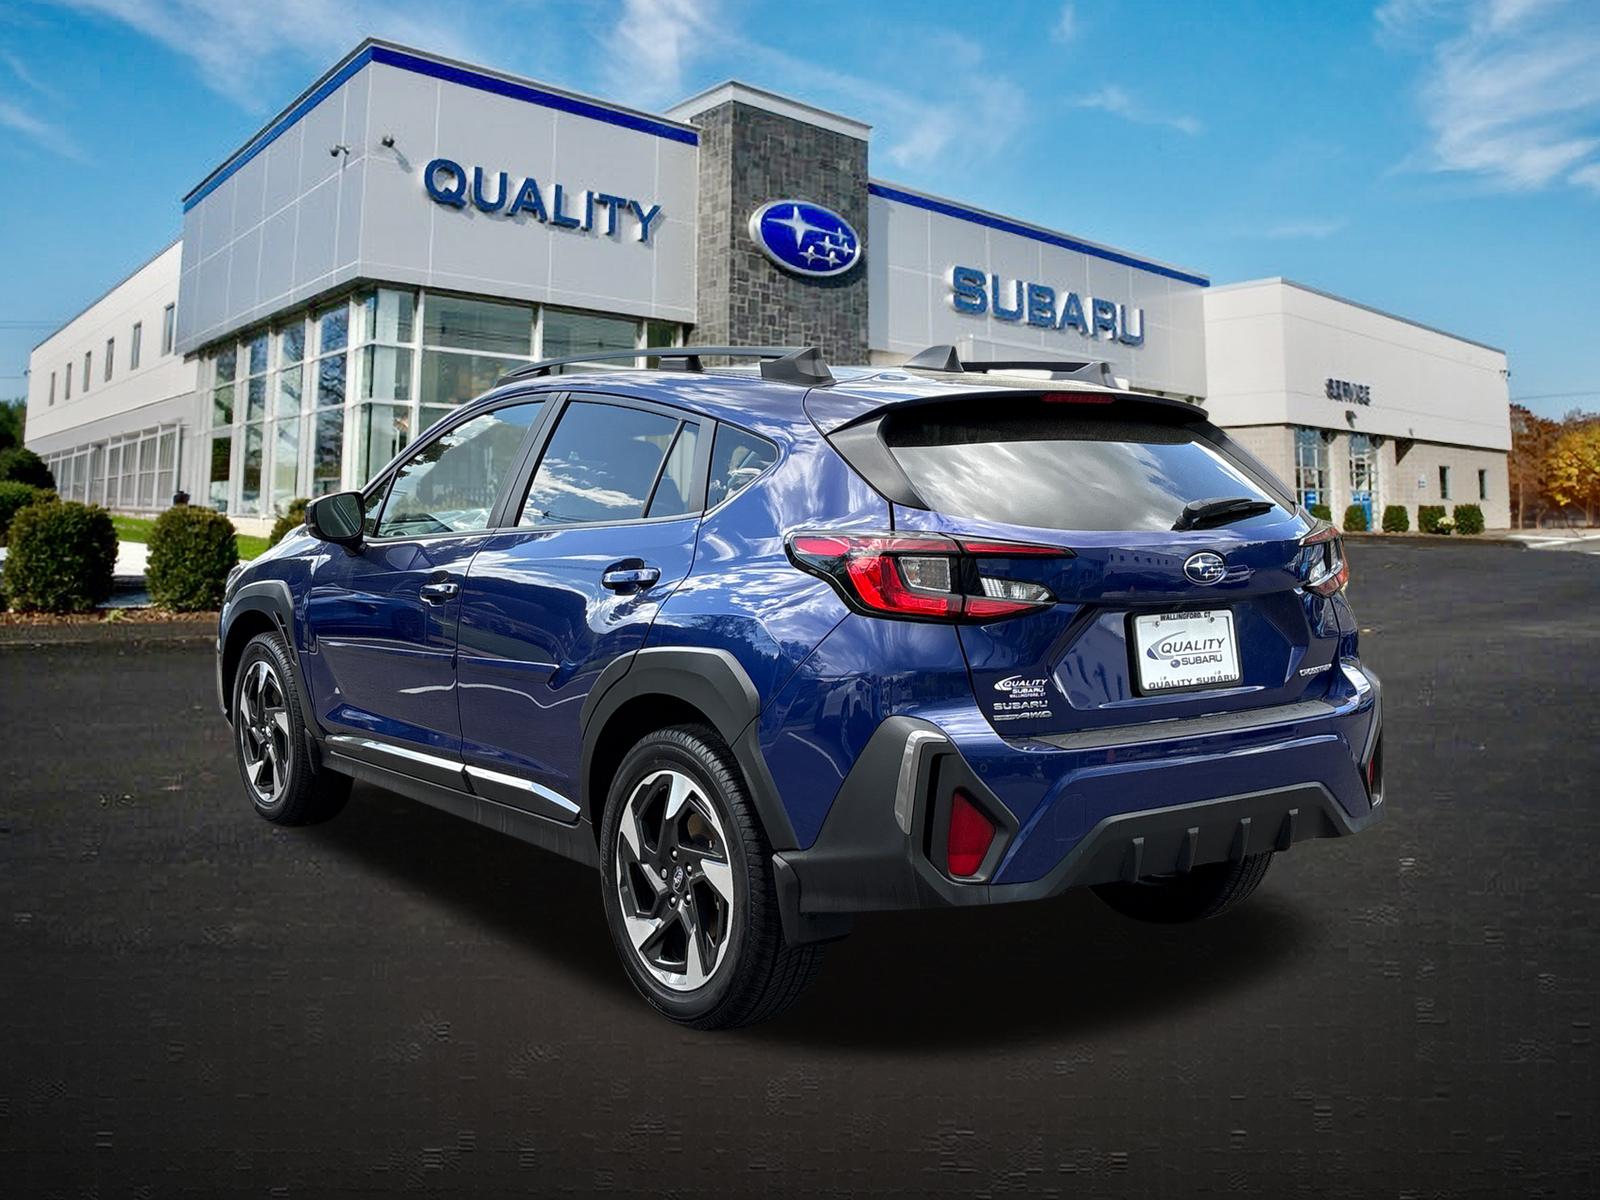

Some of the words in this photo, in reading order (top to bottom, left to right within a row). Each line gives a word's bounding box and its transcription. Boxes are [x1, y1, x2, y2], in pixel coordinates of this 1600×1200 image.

[423, 158, 662, 243] QUALITY
[950, 265, 1145, 347] SUBARU
[1161, 637, 1226, 654] QUALITY
[1181, 654, 1223, 665] SUBARU
[1004, 679, 1048, 687] QUALITY
[1148, 678, 1193, 689] QUALITY
[1196, 674, 1237, 684] SUBARU
[993, 701, 1048, 710] SUBARU
[1018, 711, 1052, 719] AWD
